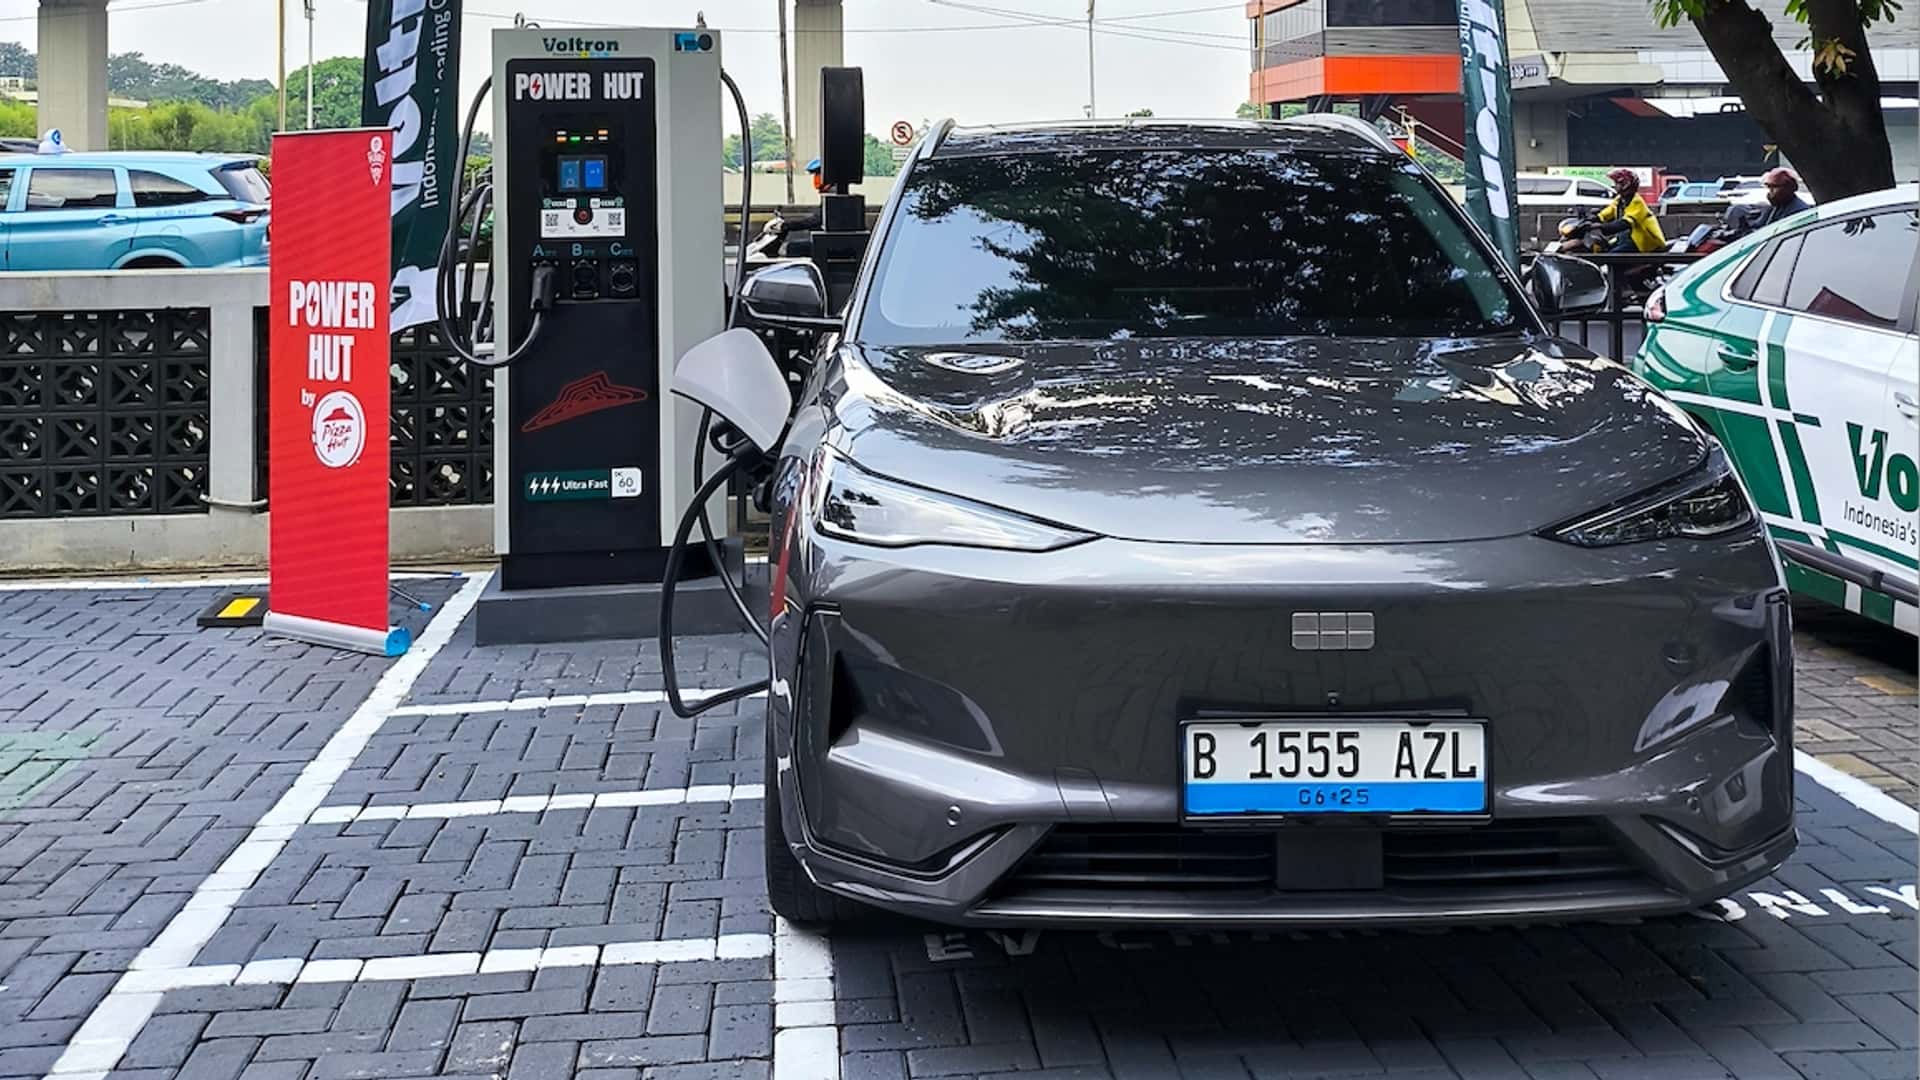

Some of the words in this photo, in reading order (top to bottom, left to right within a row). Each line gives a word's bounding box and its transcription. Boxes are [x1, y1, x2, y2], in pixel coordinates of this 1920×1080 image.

[542, 37, 619, 51] Voltron
[515, 72, 591, 100] POWER
[603, 72, 644, 99] HUT
[533, 244, 544, 256] A
[572, 243, 582, 256] B
[610, 243, 622, 255] C
[289, 280, 376, 329] POWER
[307, 333, 355, 382] HUT
[301, 388, 316, 408] by
[322, 422, 352, 442] Pizza
[327, 437, 349, 453] Hut
[562, 479, 587, 490] Ultra
[588, 479, 609, 489] Fast
[618, 476, 634, 488] 60
[1843, 500, 1917, 546] Indonesia's
[1193, 732, 1217, 779] B
[1249, 732, 1360, 779] 1555
[1395, 732, 1477, 779] AZL
